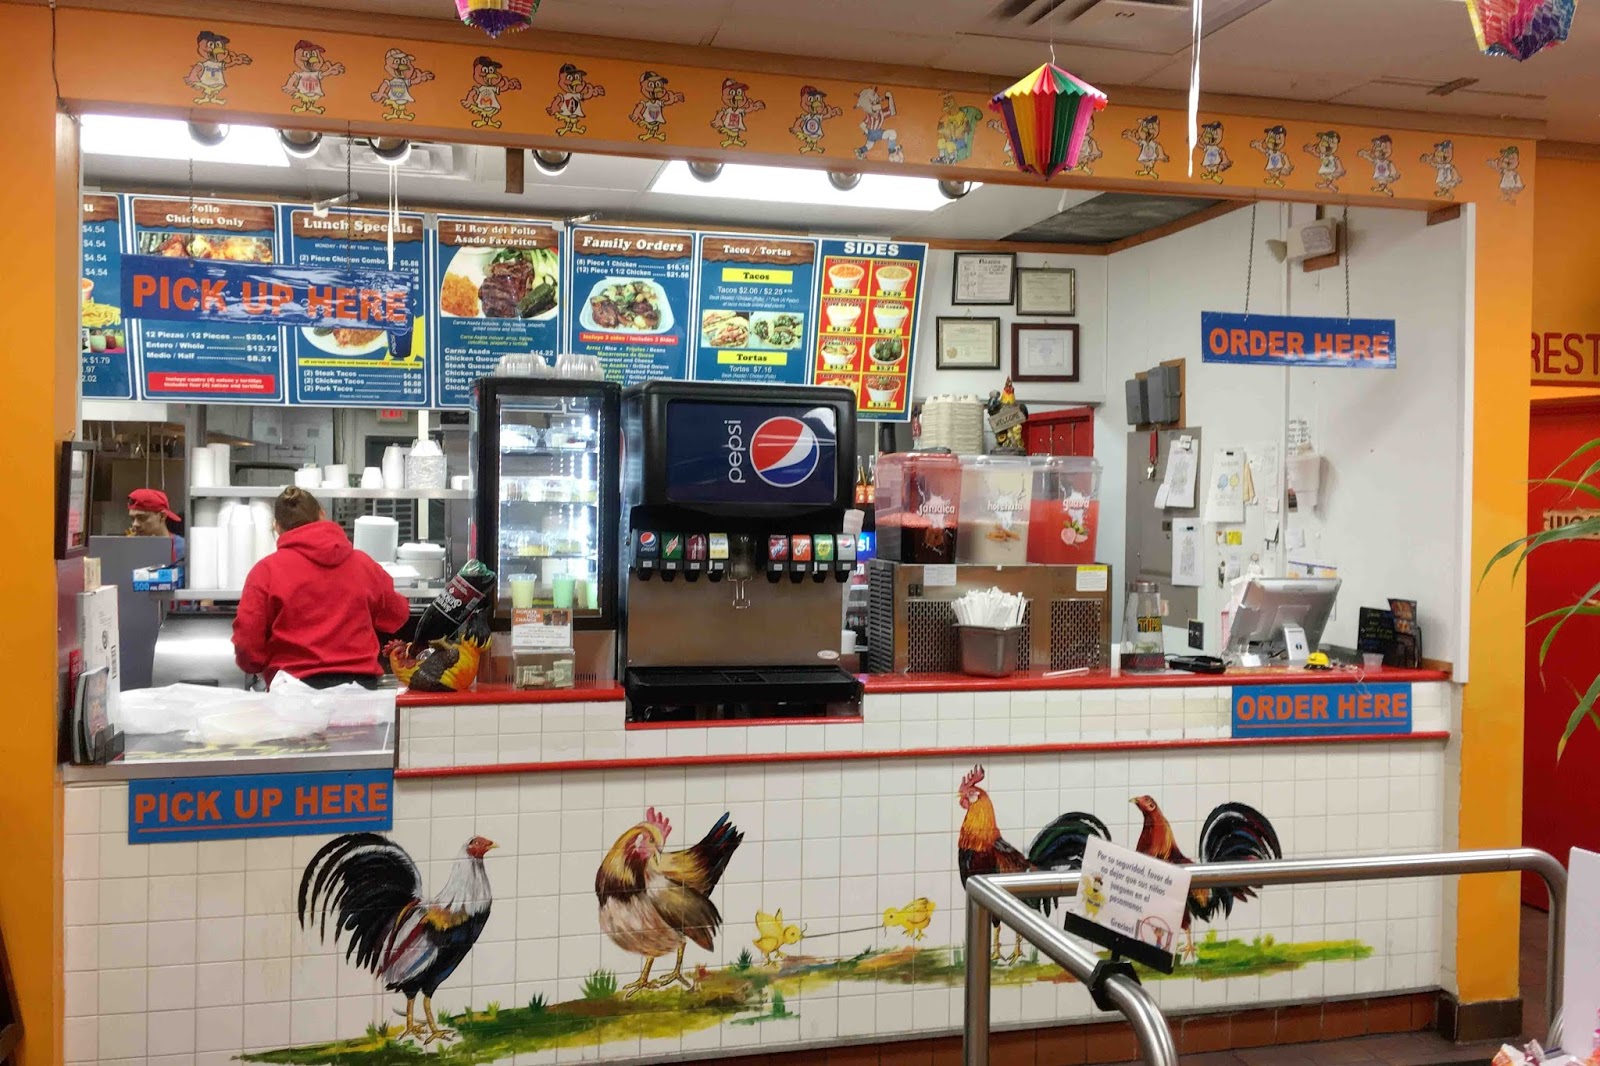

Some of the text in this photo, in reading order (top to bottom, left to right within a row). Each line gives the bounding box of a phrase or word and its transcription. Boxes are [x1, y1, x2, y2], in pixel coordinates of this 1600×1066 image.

[166, 214, 245, 228] Chicken Only
[304, 217, 414, 234] Lunch Specals
[455, 224, 536, 236] El Rey del Pollo
[84, 240, 106, 248] $4.54
[454, 234, 538, 246] Asado Favorites
[582, 236, 684, 252] Family Orders
[723, 245, 750, 254] Tacos
[760, 246, 792, 256] Tortas
[844, 242, 900, 256] SIDES
[84, 254, 107, 262] $4.54
[300, 254, 308, 262] (2)
[85, 268, 108, 276] $4.54
[743, 272, 770, 280] Tacos
[718, 286, 737, 294] Tacos
[132, 274, 408, 323] PICK UP HERE
[202, 332, 230, 340] Pieces
[246, 334, 276, 342] $20.14
[1210, 328, 1390, 360] ORDER HERE
[90, 356, 110, 364] $1.79
[724, 420, 746, 484] pepsi
[917, 502, 955, 516] jamaica
[1062, 498, 1090, 510] guava
[134, 582, 150, 592] 500
[1237, 694, 1408, 720] ORDER HERE
[134, 783, 388, 824] PICK UP HERE
[1097, 850, 1106, 861] Por
[1108, 856, 1115, 864] su
[1148, 868, 1163, 882] favor
[1164, 876, 1173, 886] de
[1100, 866, 1108, 874] no
[1110, 868, 1124, 880] dejar
[1126, 876, 1137, 886] que
[1138, 880, 1148, 890] sus
[1135, 891, 1142, 900] en
[1144, 892, 1150, 902] el
